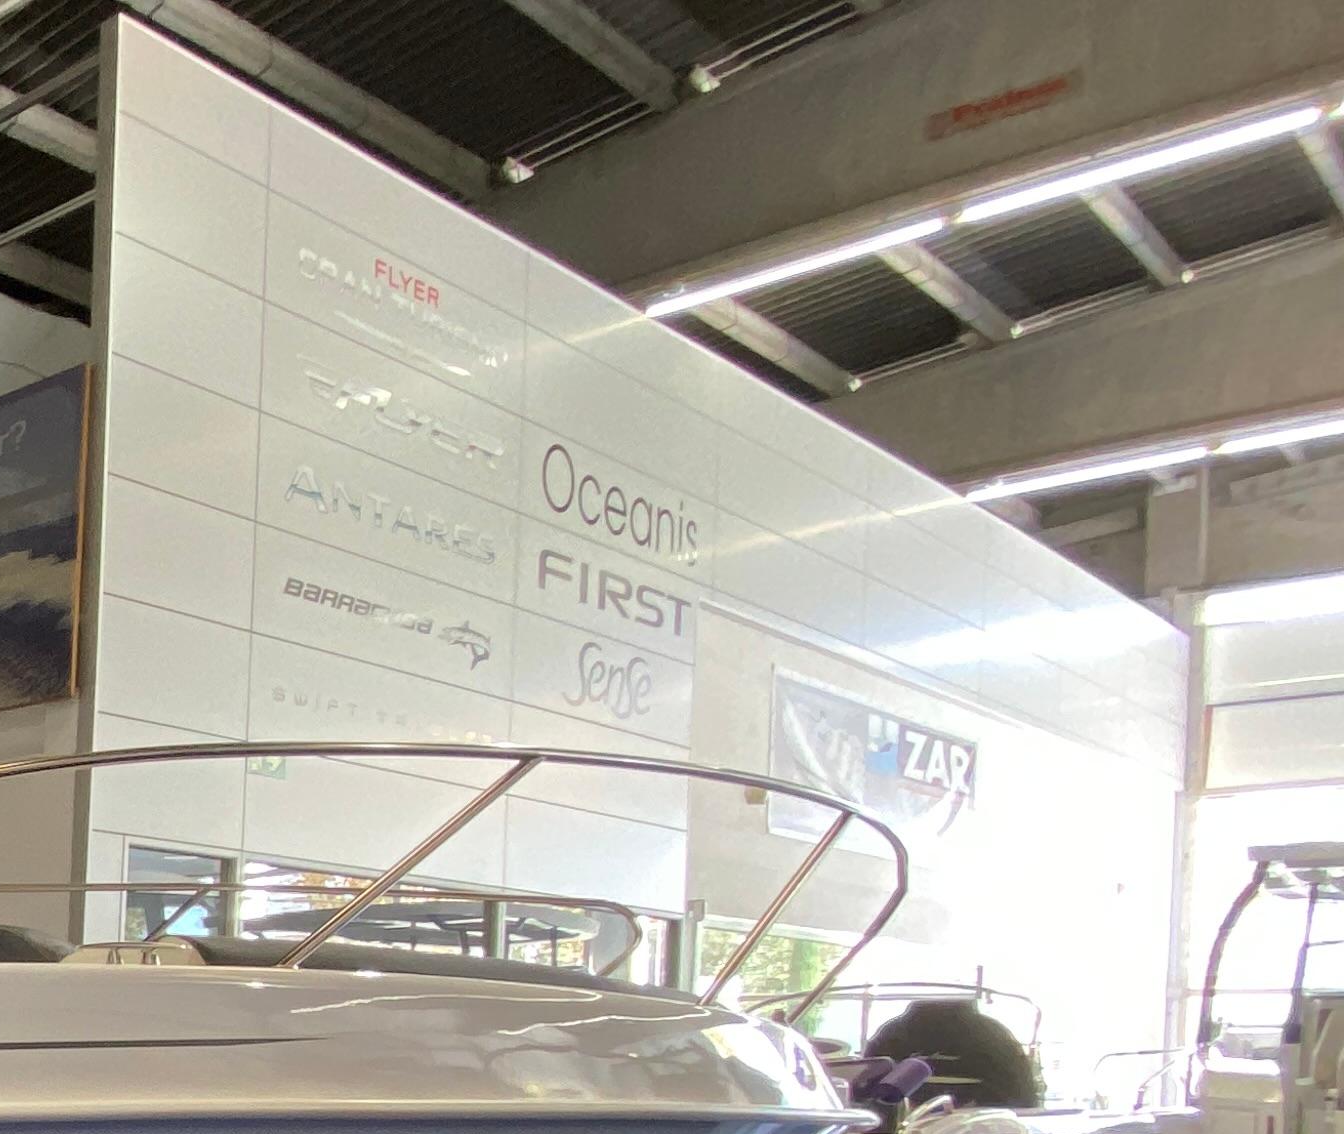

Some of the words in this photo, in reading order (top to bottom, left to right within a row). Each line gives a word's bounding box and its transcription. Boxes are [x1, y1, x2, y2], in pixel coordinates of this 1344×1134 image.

[373, 257, 440, 309] FLYER
[284, 465, 496, 565] ANTARES
[542, 443, 698, 567] Oceanis
[538, 549, 692, 636] FIRST
[903, 729, 972, 796] ZAR
